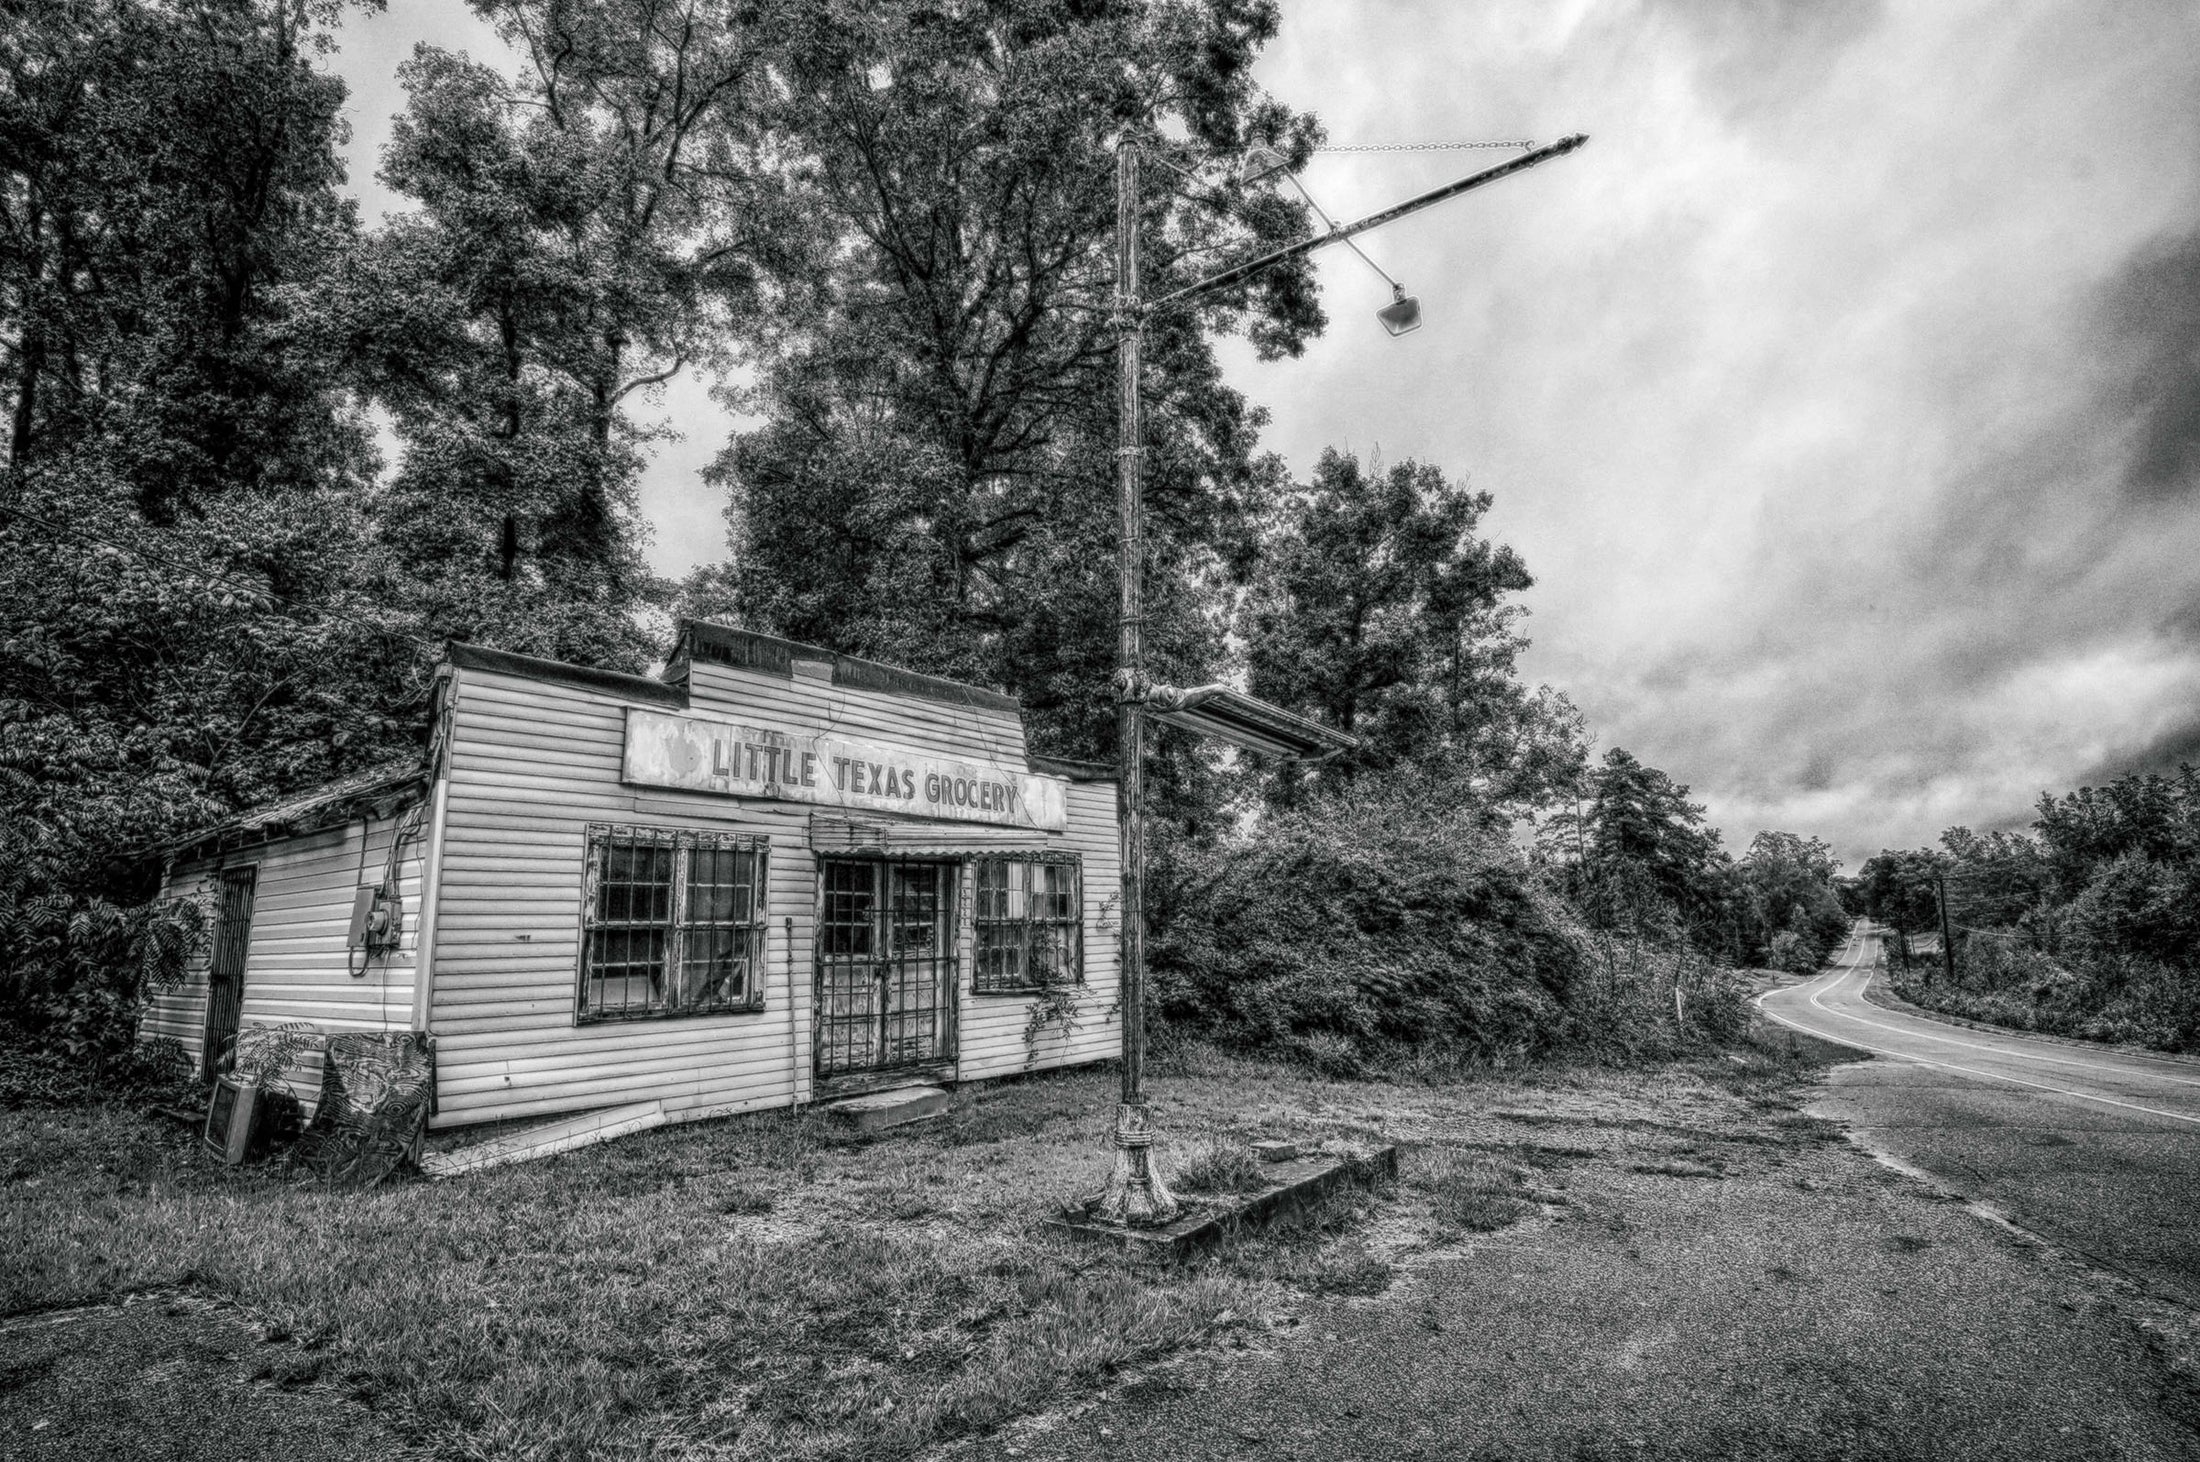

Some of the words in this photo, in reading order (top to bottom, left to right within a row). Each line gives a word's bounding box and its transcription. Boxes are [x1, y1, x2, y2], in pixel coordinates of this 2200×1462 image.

[713, 739, 816, 787] LITTLE
[834, 756, 915, 800] TEXAS
[925, 773, 1018, 814] GROCERY
